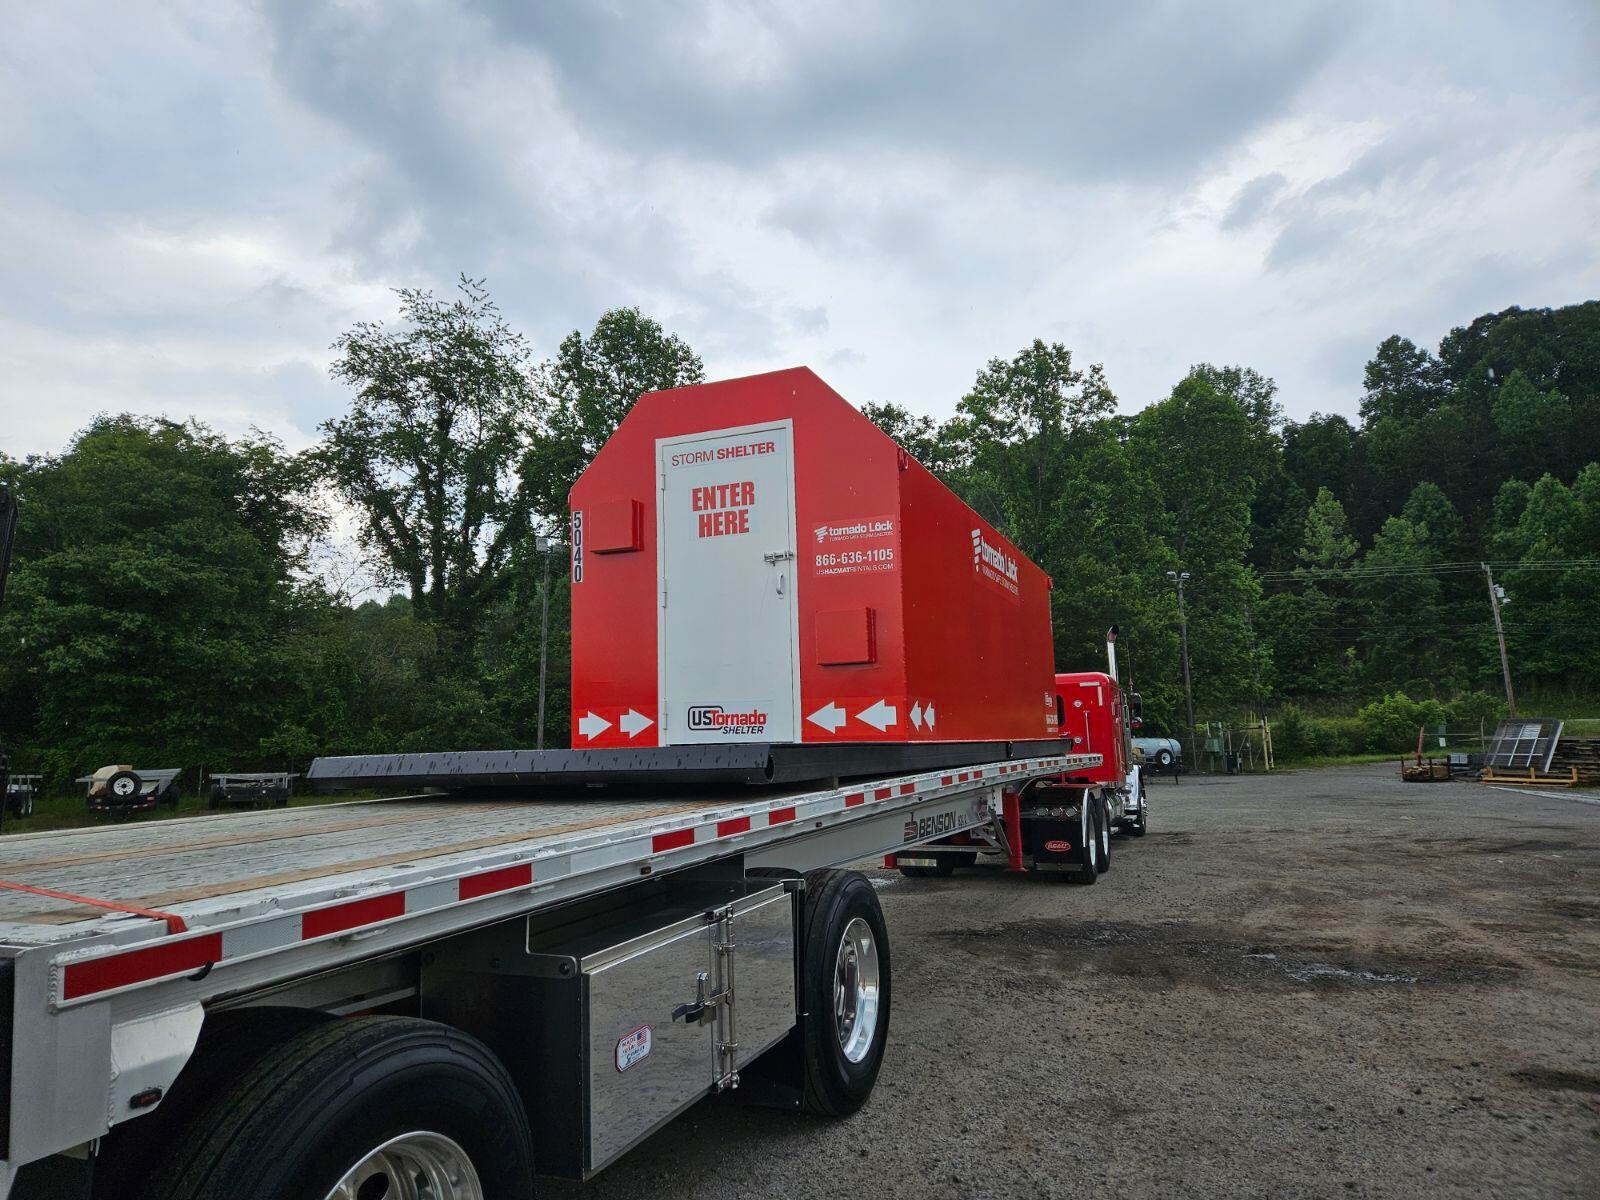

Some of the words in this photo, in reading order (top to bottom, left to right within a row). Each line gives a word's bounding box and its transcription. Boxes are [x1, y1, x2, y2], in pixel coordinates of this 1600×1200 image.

[671, 450, 714, 467] STORM
[717, 441, 775, 460] SHELTER
[692, 481, 755, 512] ENTER
[698, 509, 750, 538] HERE
[829, 523, 867, 536] tornado
[573, 511, 582, 583] 5040
[815, 548, 894, 567] 866-636-1105
[722, 726, 764, 735] SHELTER
[919, 811, 957, 838] BENSON
